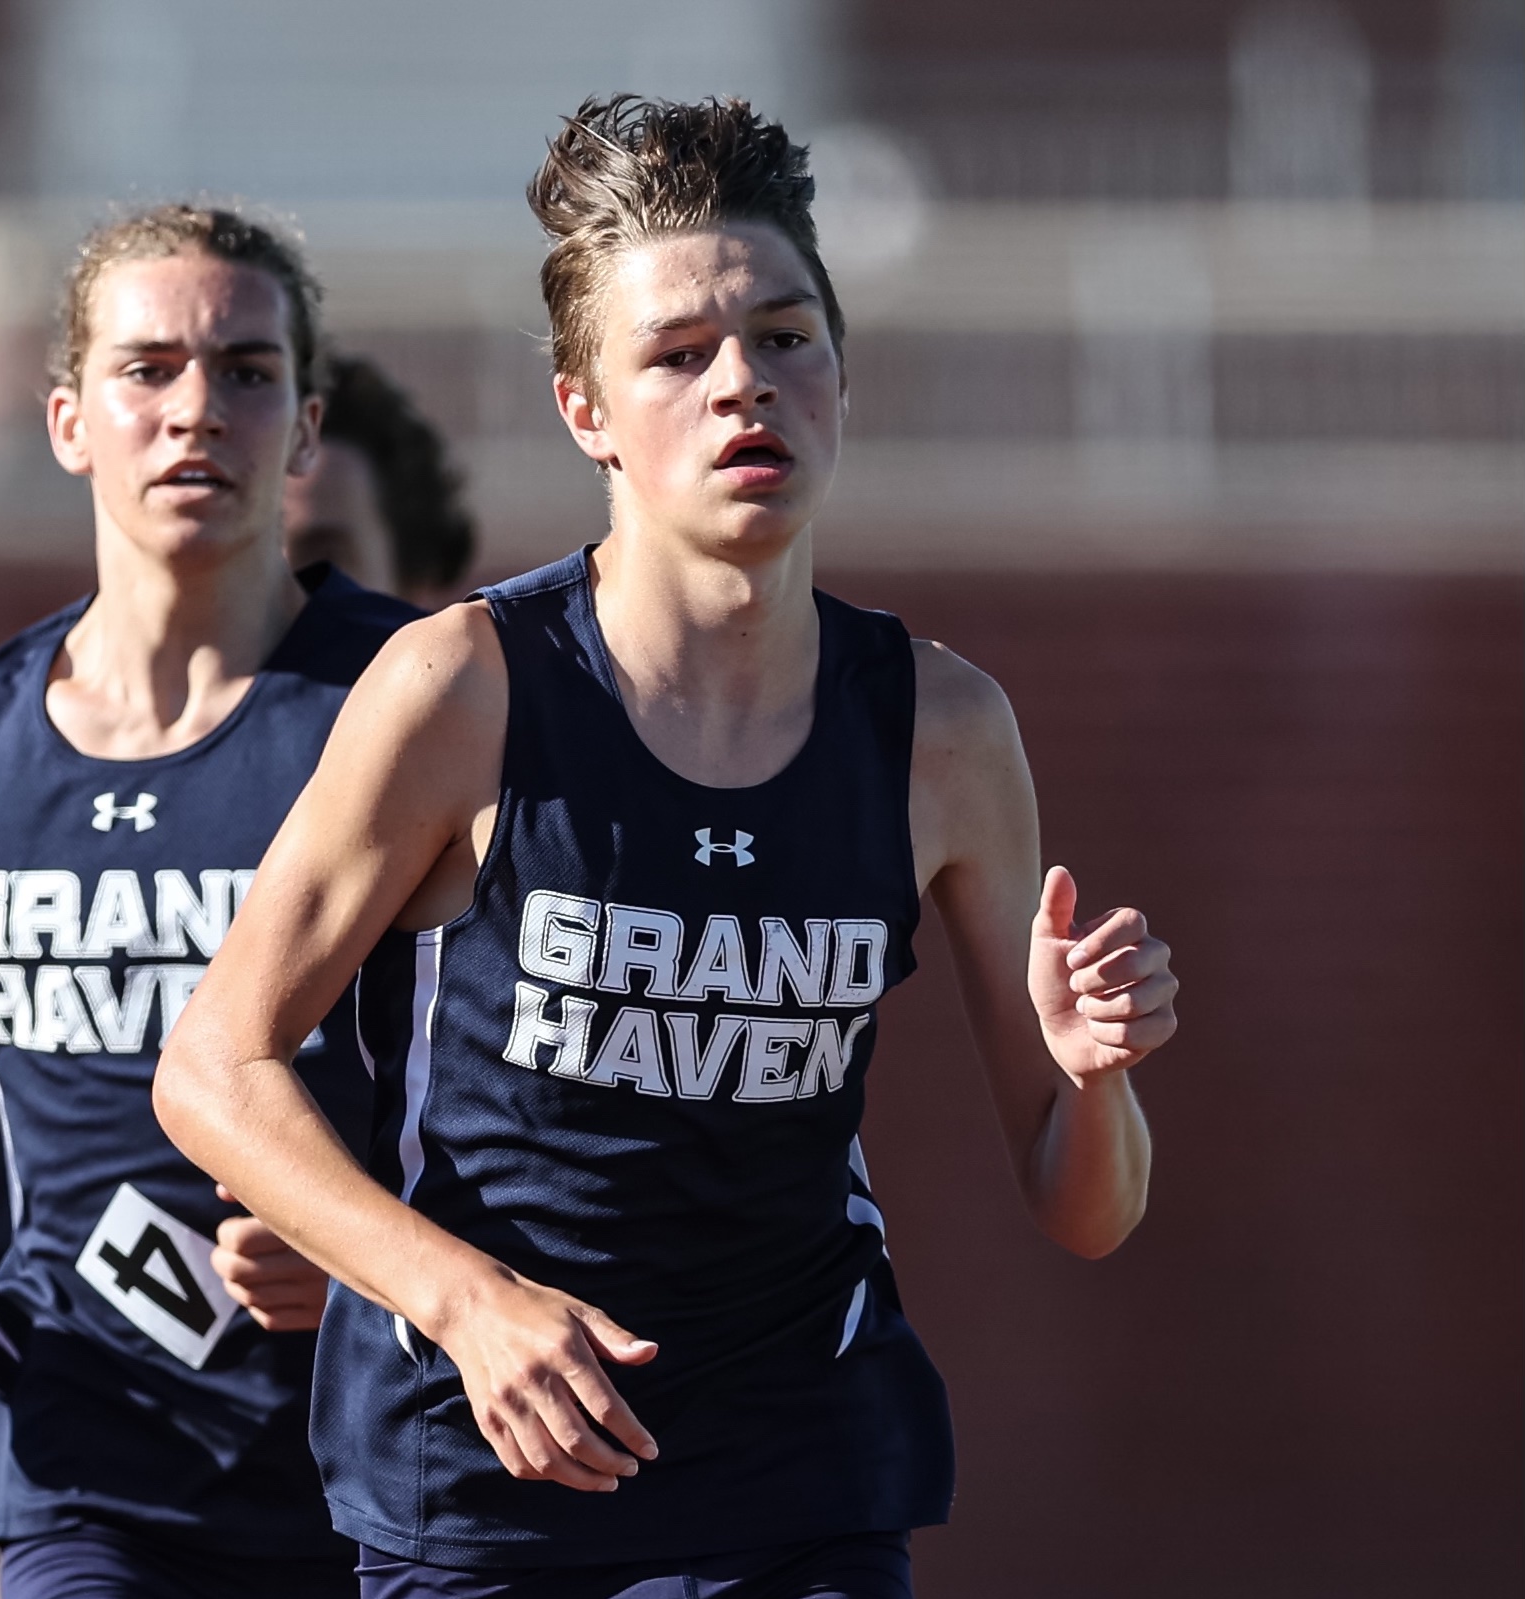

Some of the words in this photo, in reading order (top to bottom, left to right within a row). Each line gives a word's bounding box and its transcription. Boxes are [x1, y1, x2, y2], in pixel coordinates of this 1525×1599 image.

[517, 889, 888, 1007] GRAND
[502, 980, 871, 1103] HAVEN
[97, 1221, 217, 1338] 4
